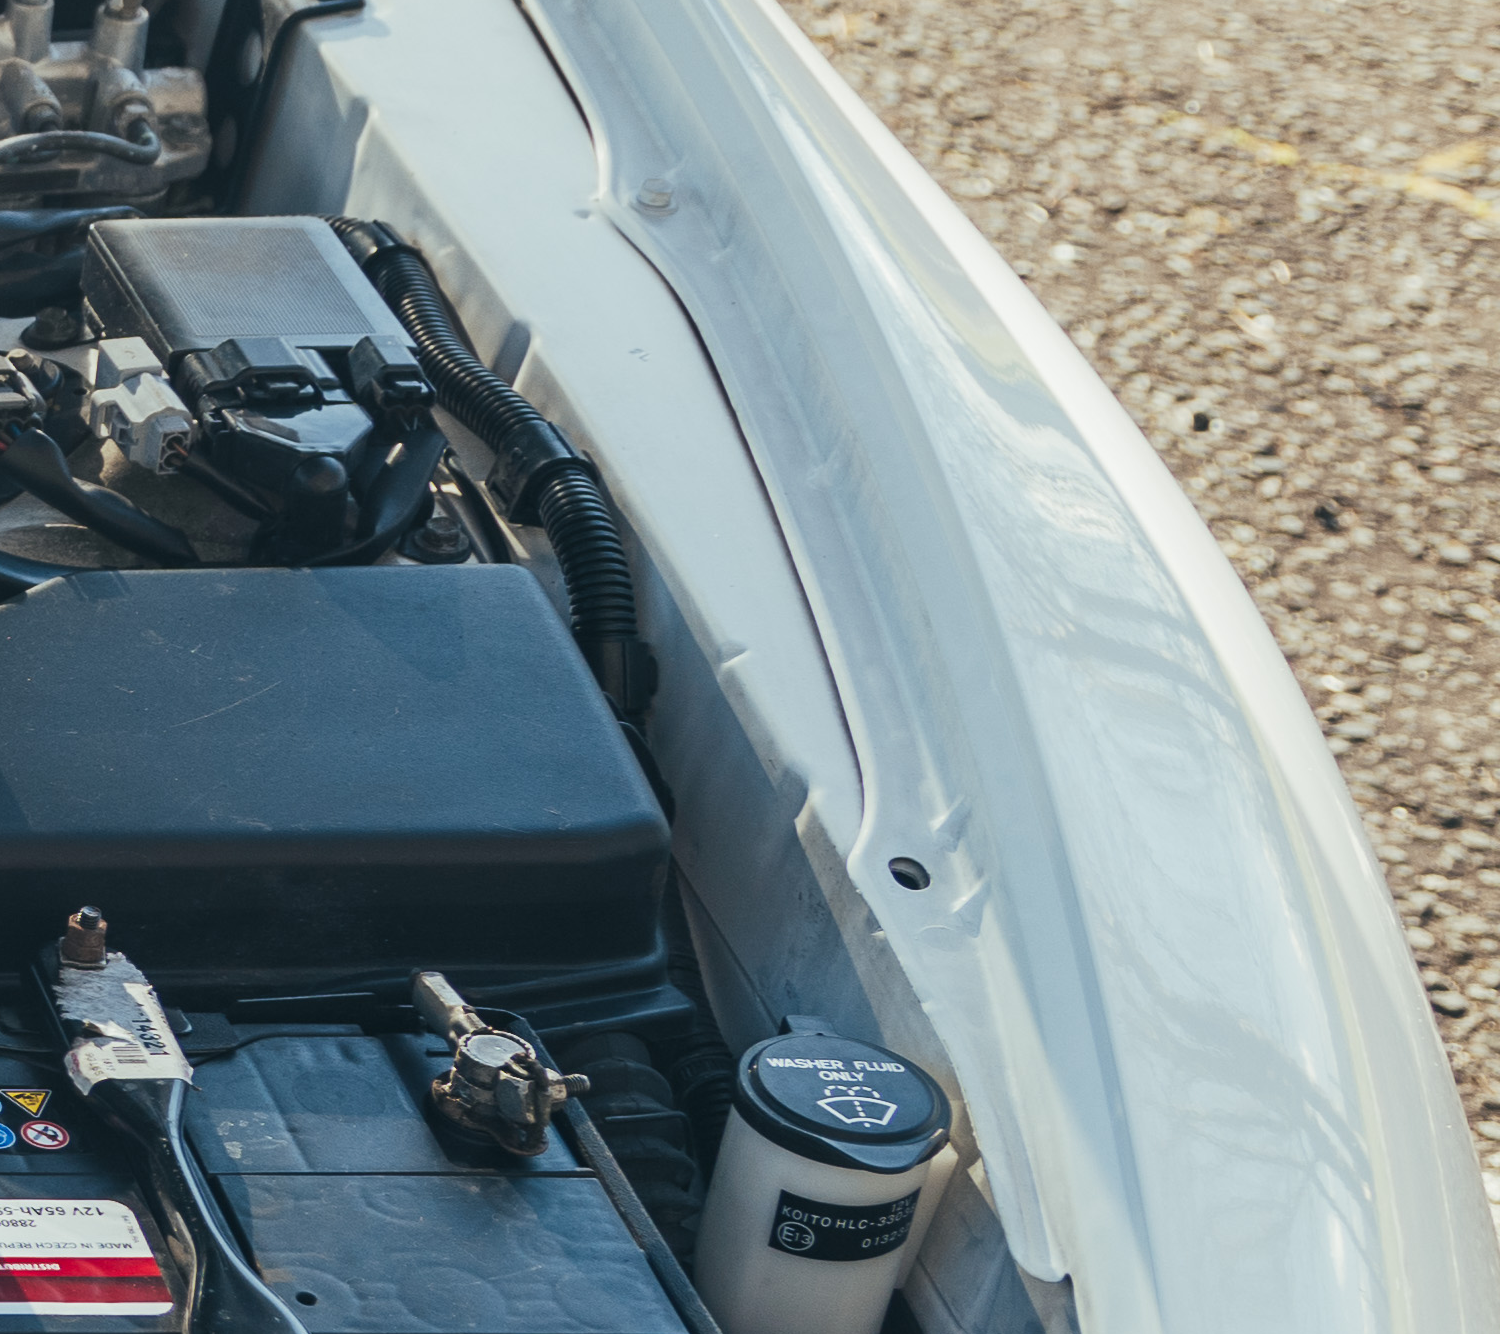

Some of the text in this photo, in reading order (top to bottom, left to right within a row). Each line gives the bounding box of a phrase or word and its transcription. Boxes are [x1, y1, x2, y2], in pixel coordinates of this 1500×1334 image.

[766, 1057, 905, 1074] WASHER FLUID
[818, 1070, 865, 1082] ONLY
[72, 1205, 104, 1216] 12V
[781, 1205, 832, 1227] KOITO
[30, 1241, 77, 1250] CZECH
[80, 1242, 93, 1250] IN
[96, 1241, 132, 1250] MADE
